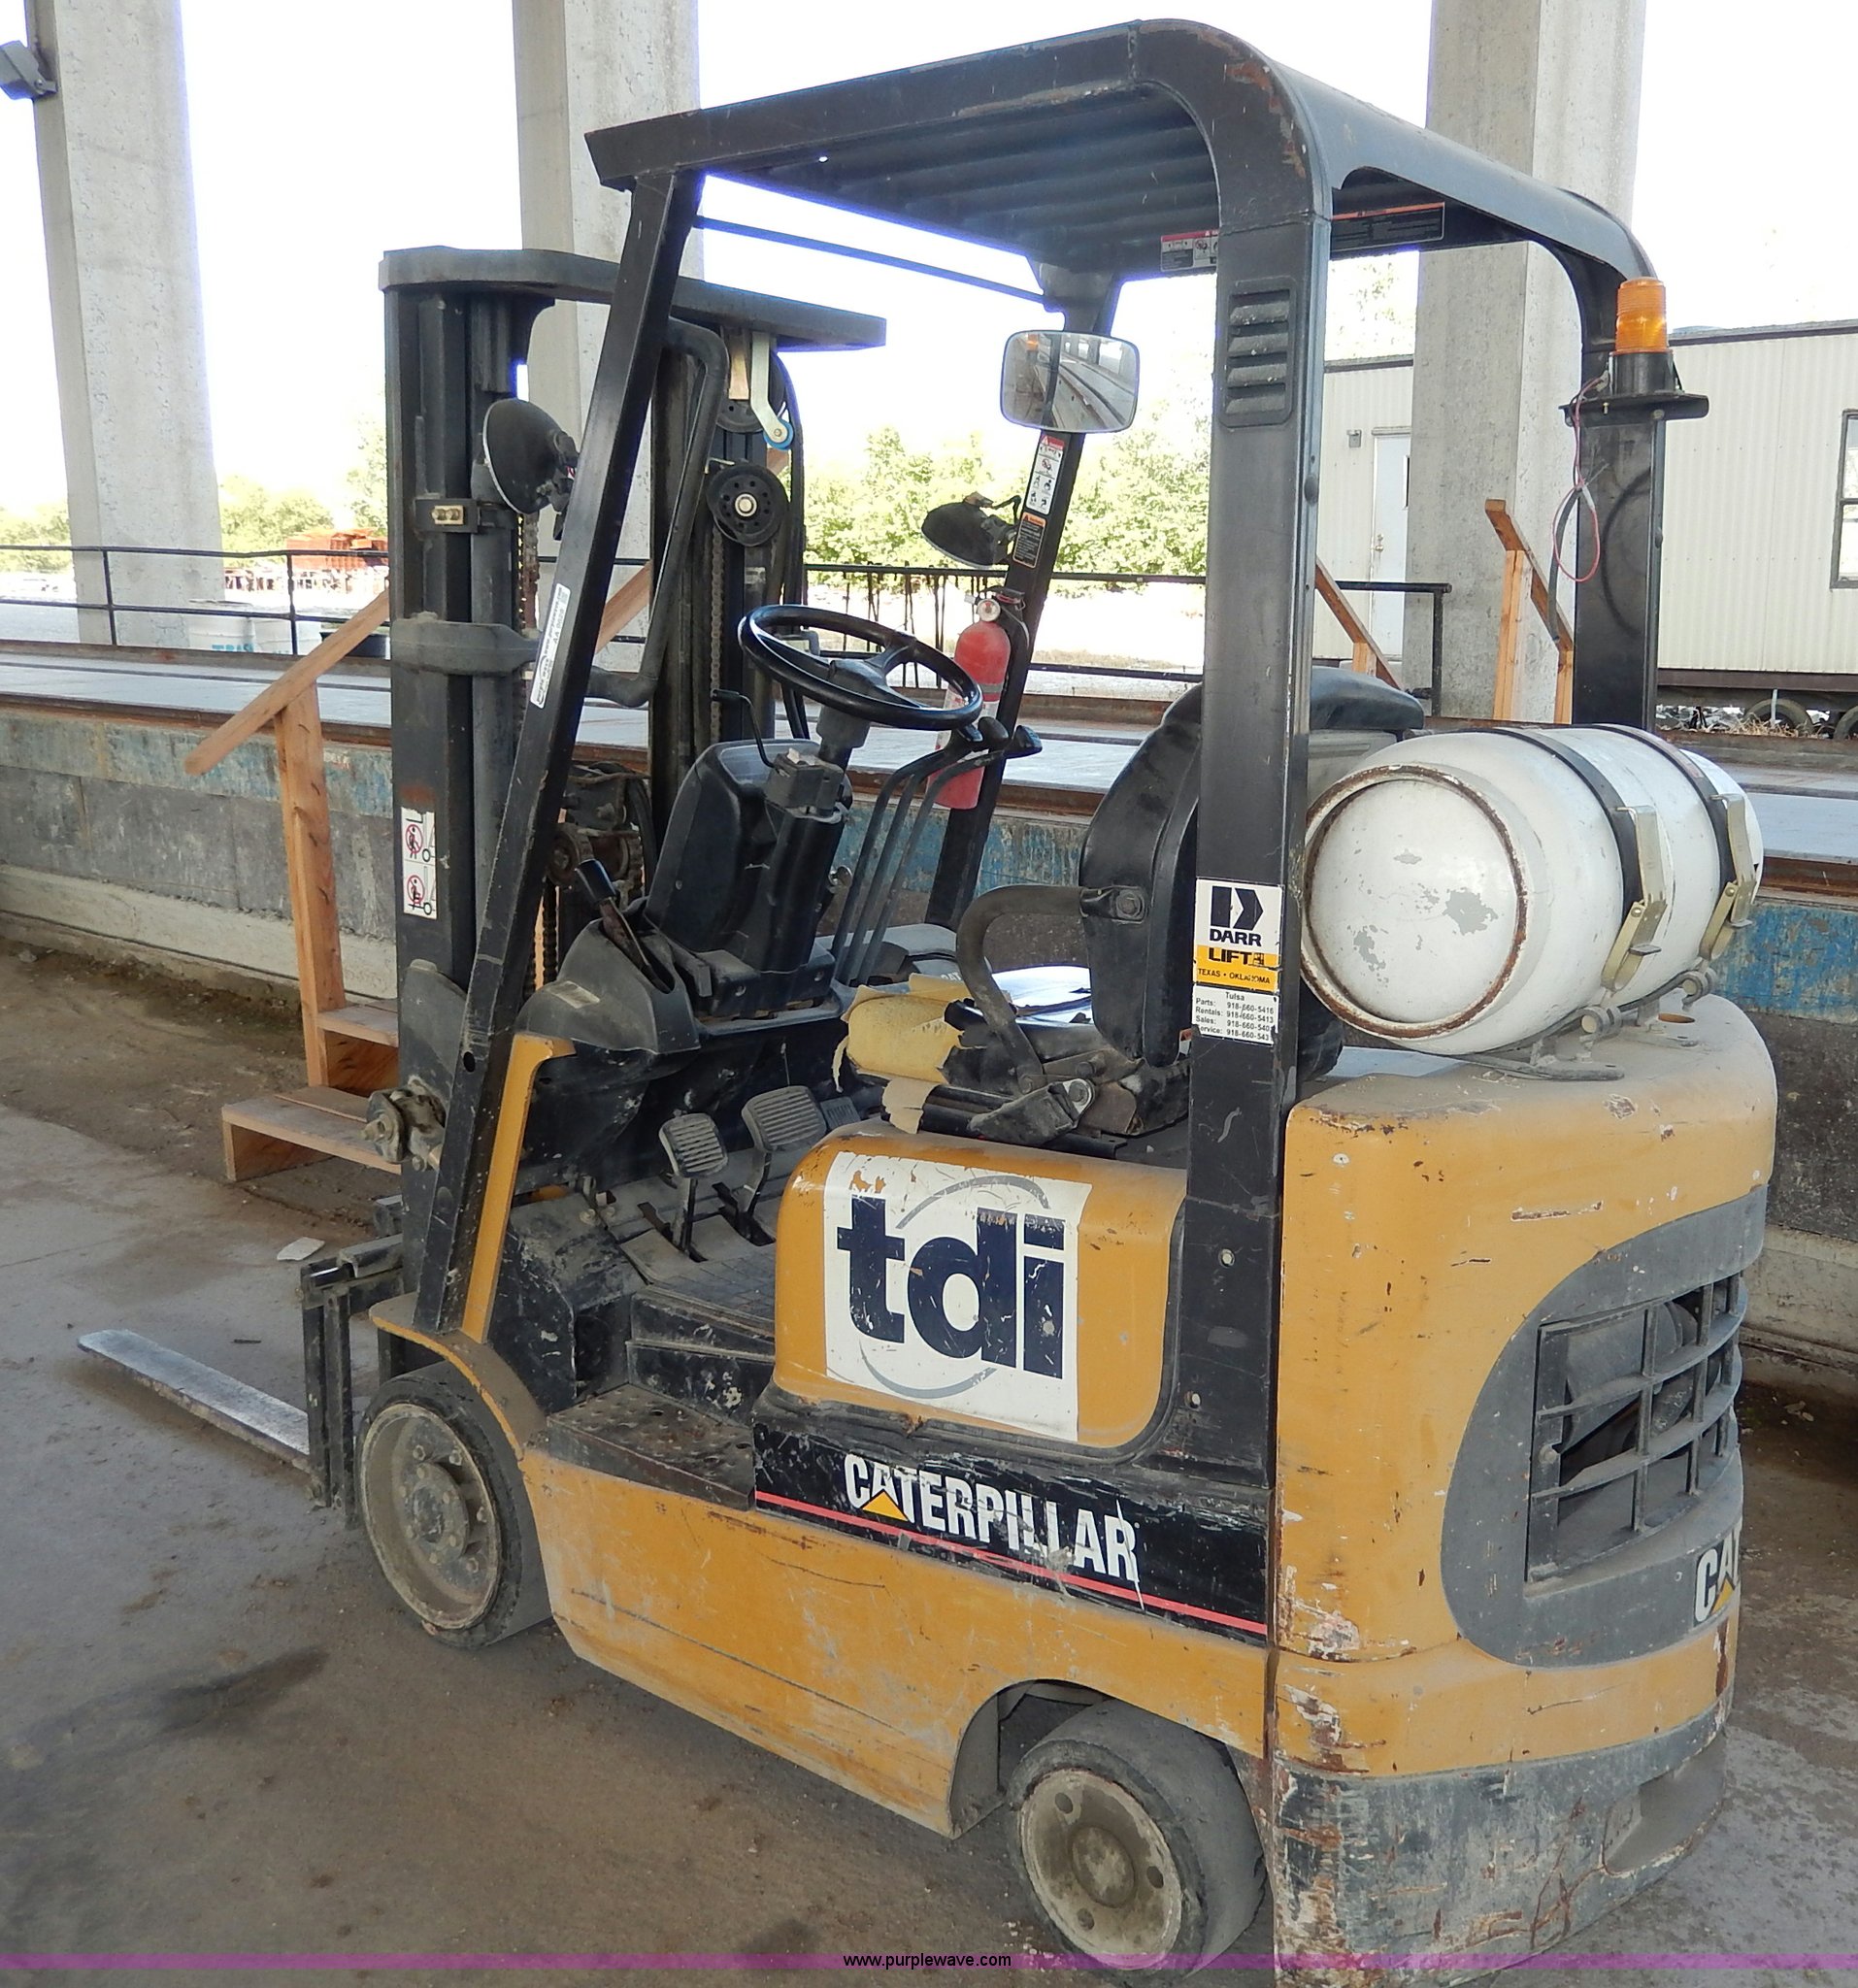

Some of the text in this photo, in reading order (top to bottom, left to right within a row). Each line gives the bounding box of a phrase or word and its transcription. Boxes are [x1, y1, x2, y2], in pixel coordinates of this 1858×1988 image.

[1210, 929, 1262, 946] DARR
[1209, 947, 1252, 965] LIFT
[1198, 968, 1221, 977] TEXAS
[1225, 991, 1245, 1001] Tulsa
[1195, 997, 1216, 1007] Parts:
[1195, 1006, 1224, 1017] Rentals:
[1195, 1015, 1217, 1025] Sales:
[1200, 1026, 1223, 1035] ervice:
[837, 1194, 1066, 1379] tdi
[844, 1452, 1140, 1583] CATERPILLAR
